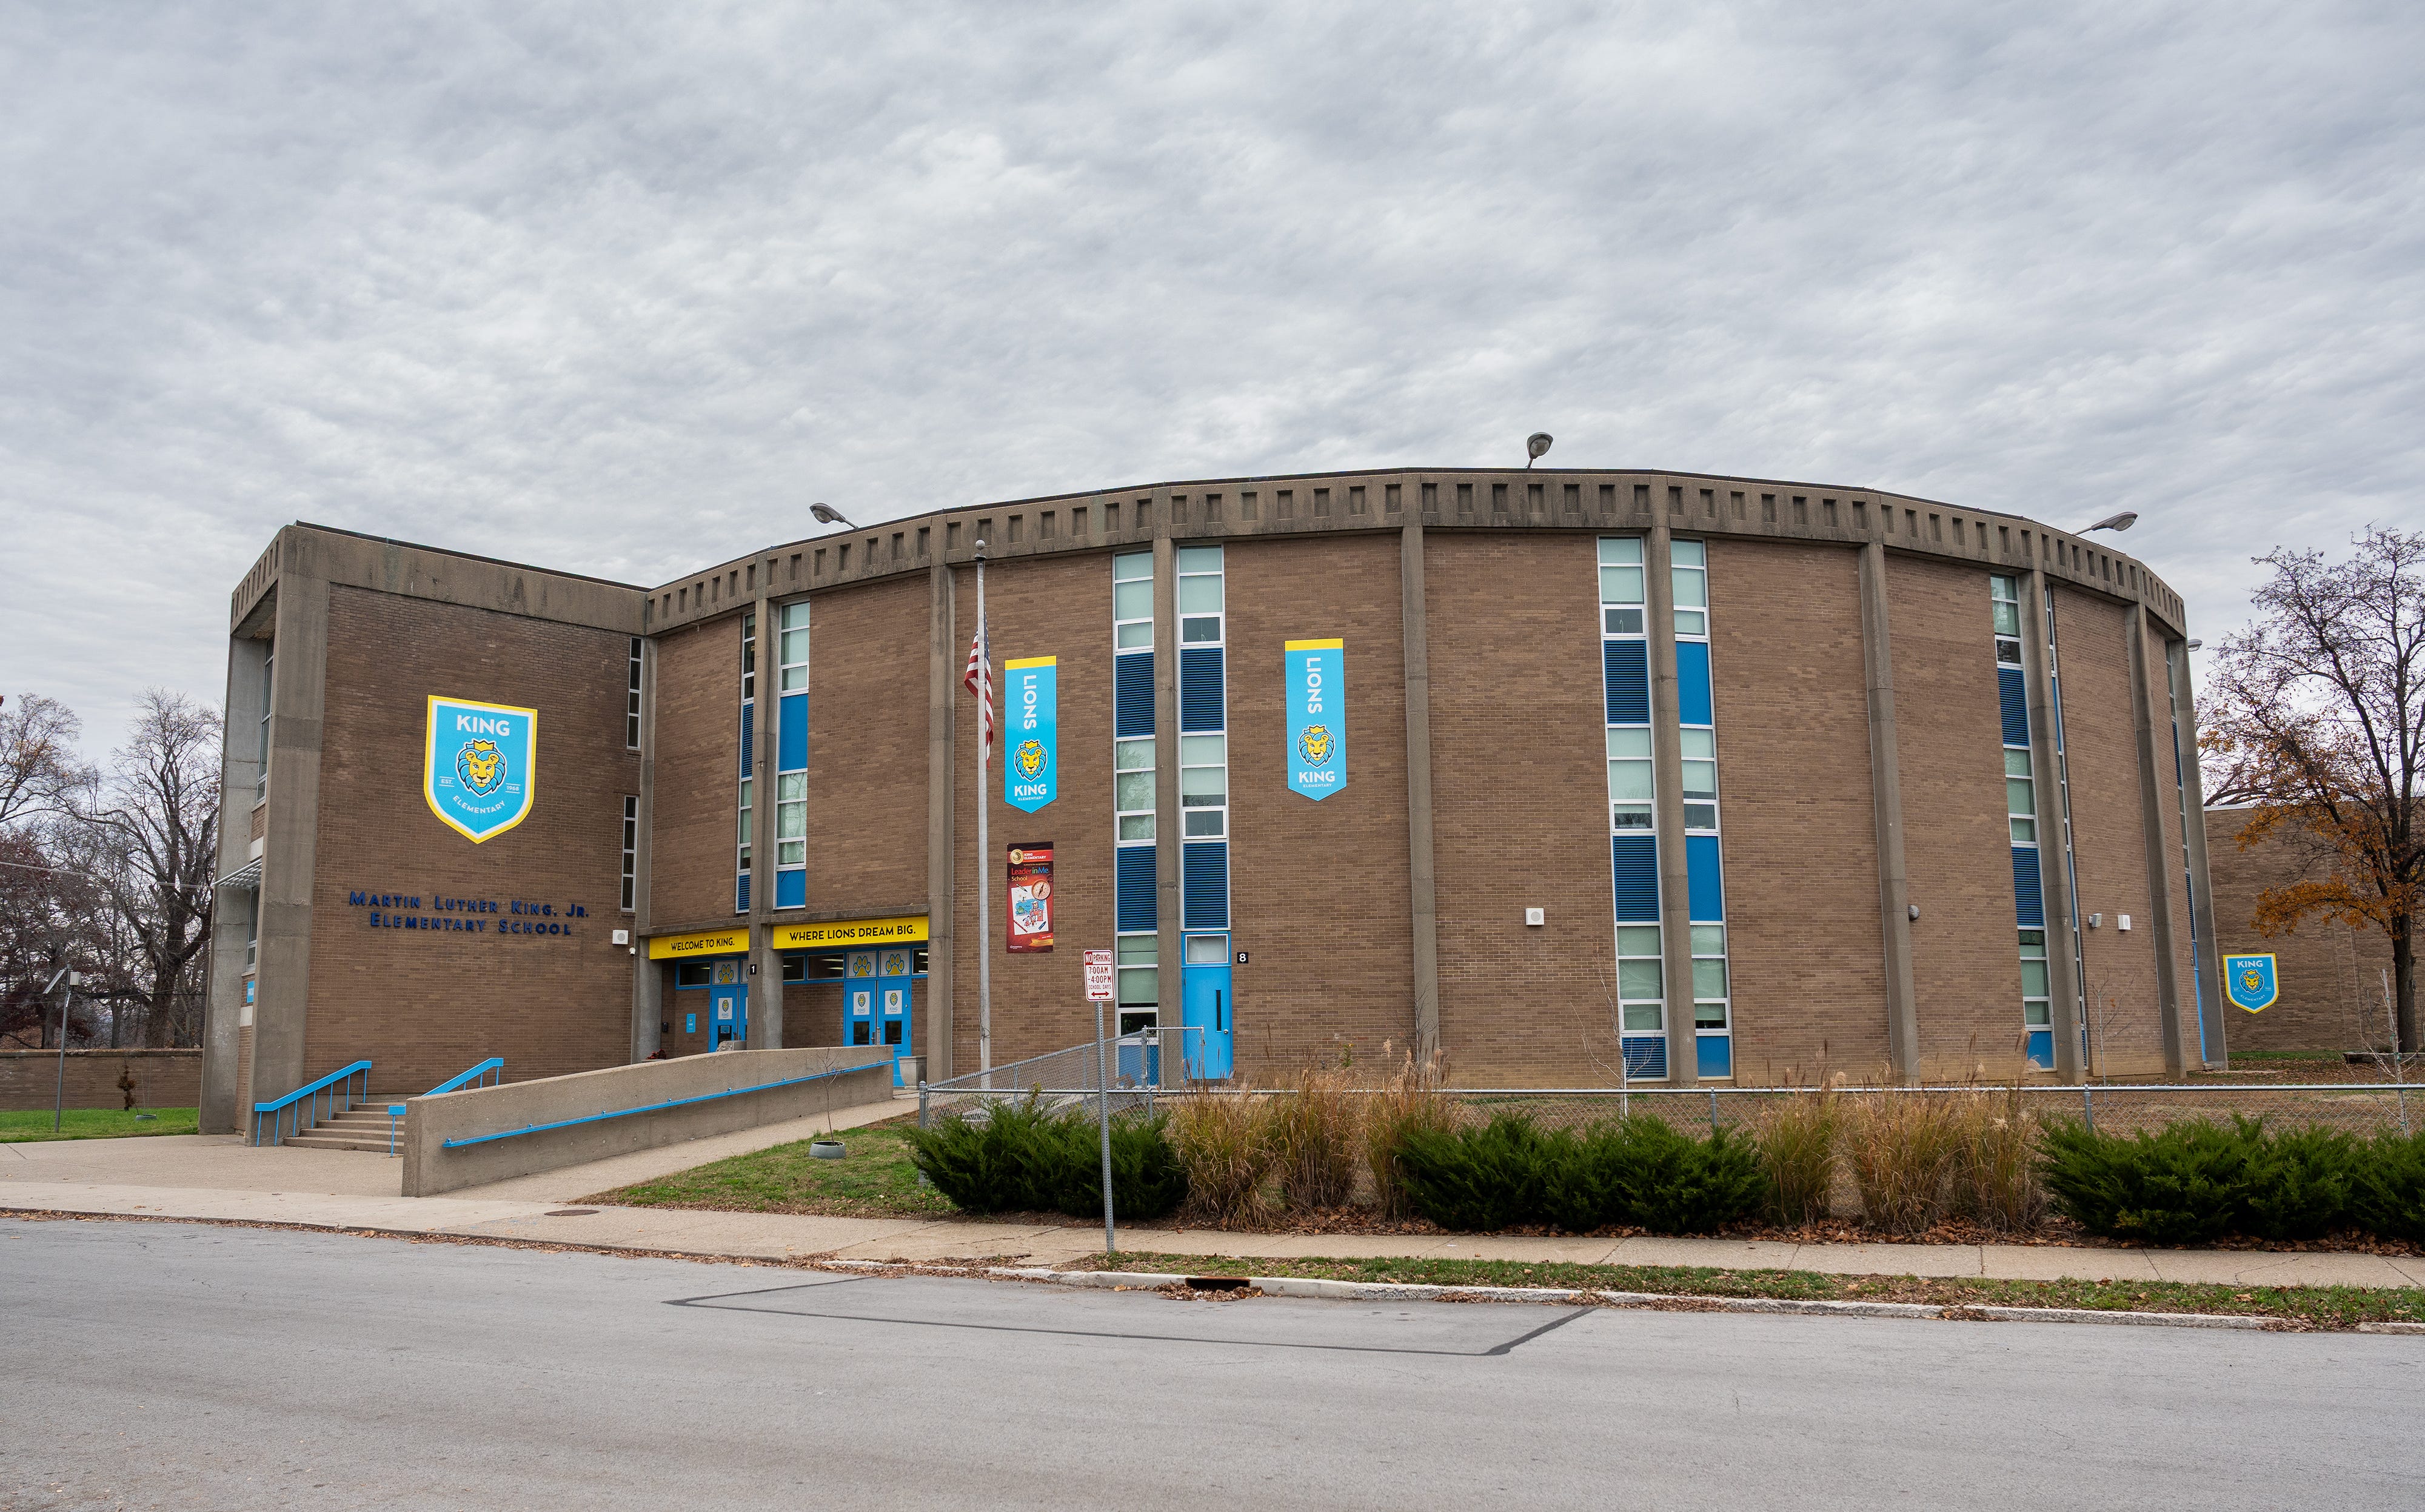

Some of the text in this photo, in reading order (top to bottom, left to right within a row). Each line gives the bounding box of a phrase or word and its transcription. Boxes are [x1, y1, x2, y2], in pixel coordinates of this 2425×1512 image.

[1306, 657, 1322, 714] LIONS
[1023, 675, 1037, 729] LIONS
[457, 714, 510, 736] KING
[1299, 771, 1335, 783] KING
[1014, 784, 1046, 797] KING
[453, 795, 506, 814] ELEMENTARY
[349, 891, 421, 908] MARTIN
[435, 895, 498, 912] LUTHER
[370, 912, 571, 935] ELEMENTARY SCHOOL
[789, 925, 916, 941] WHERE LIONS DREAM BIG.
[671, 937, 735, 951] WELCOME TO KING.
[1085, 954, 1092, 963] NO
[1239, 953, 1246, 962] 8
